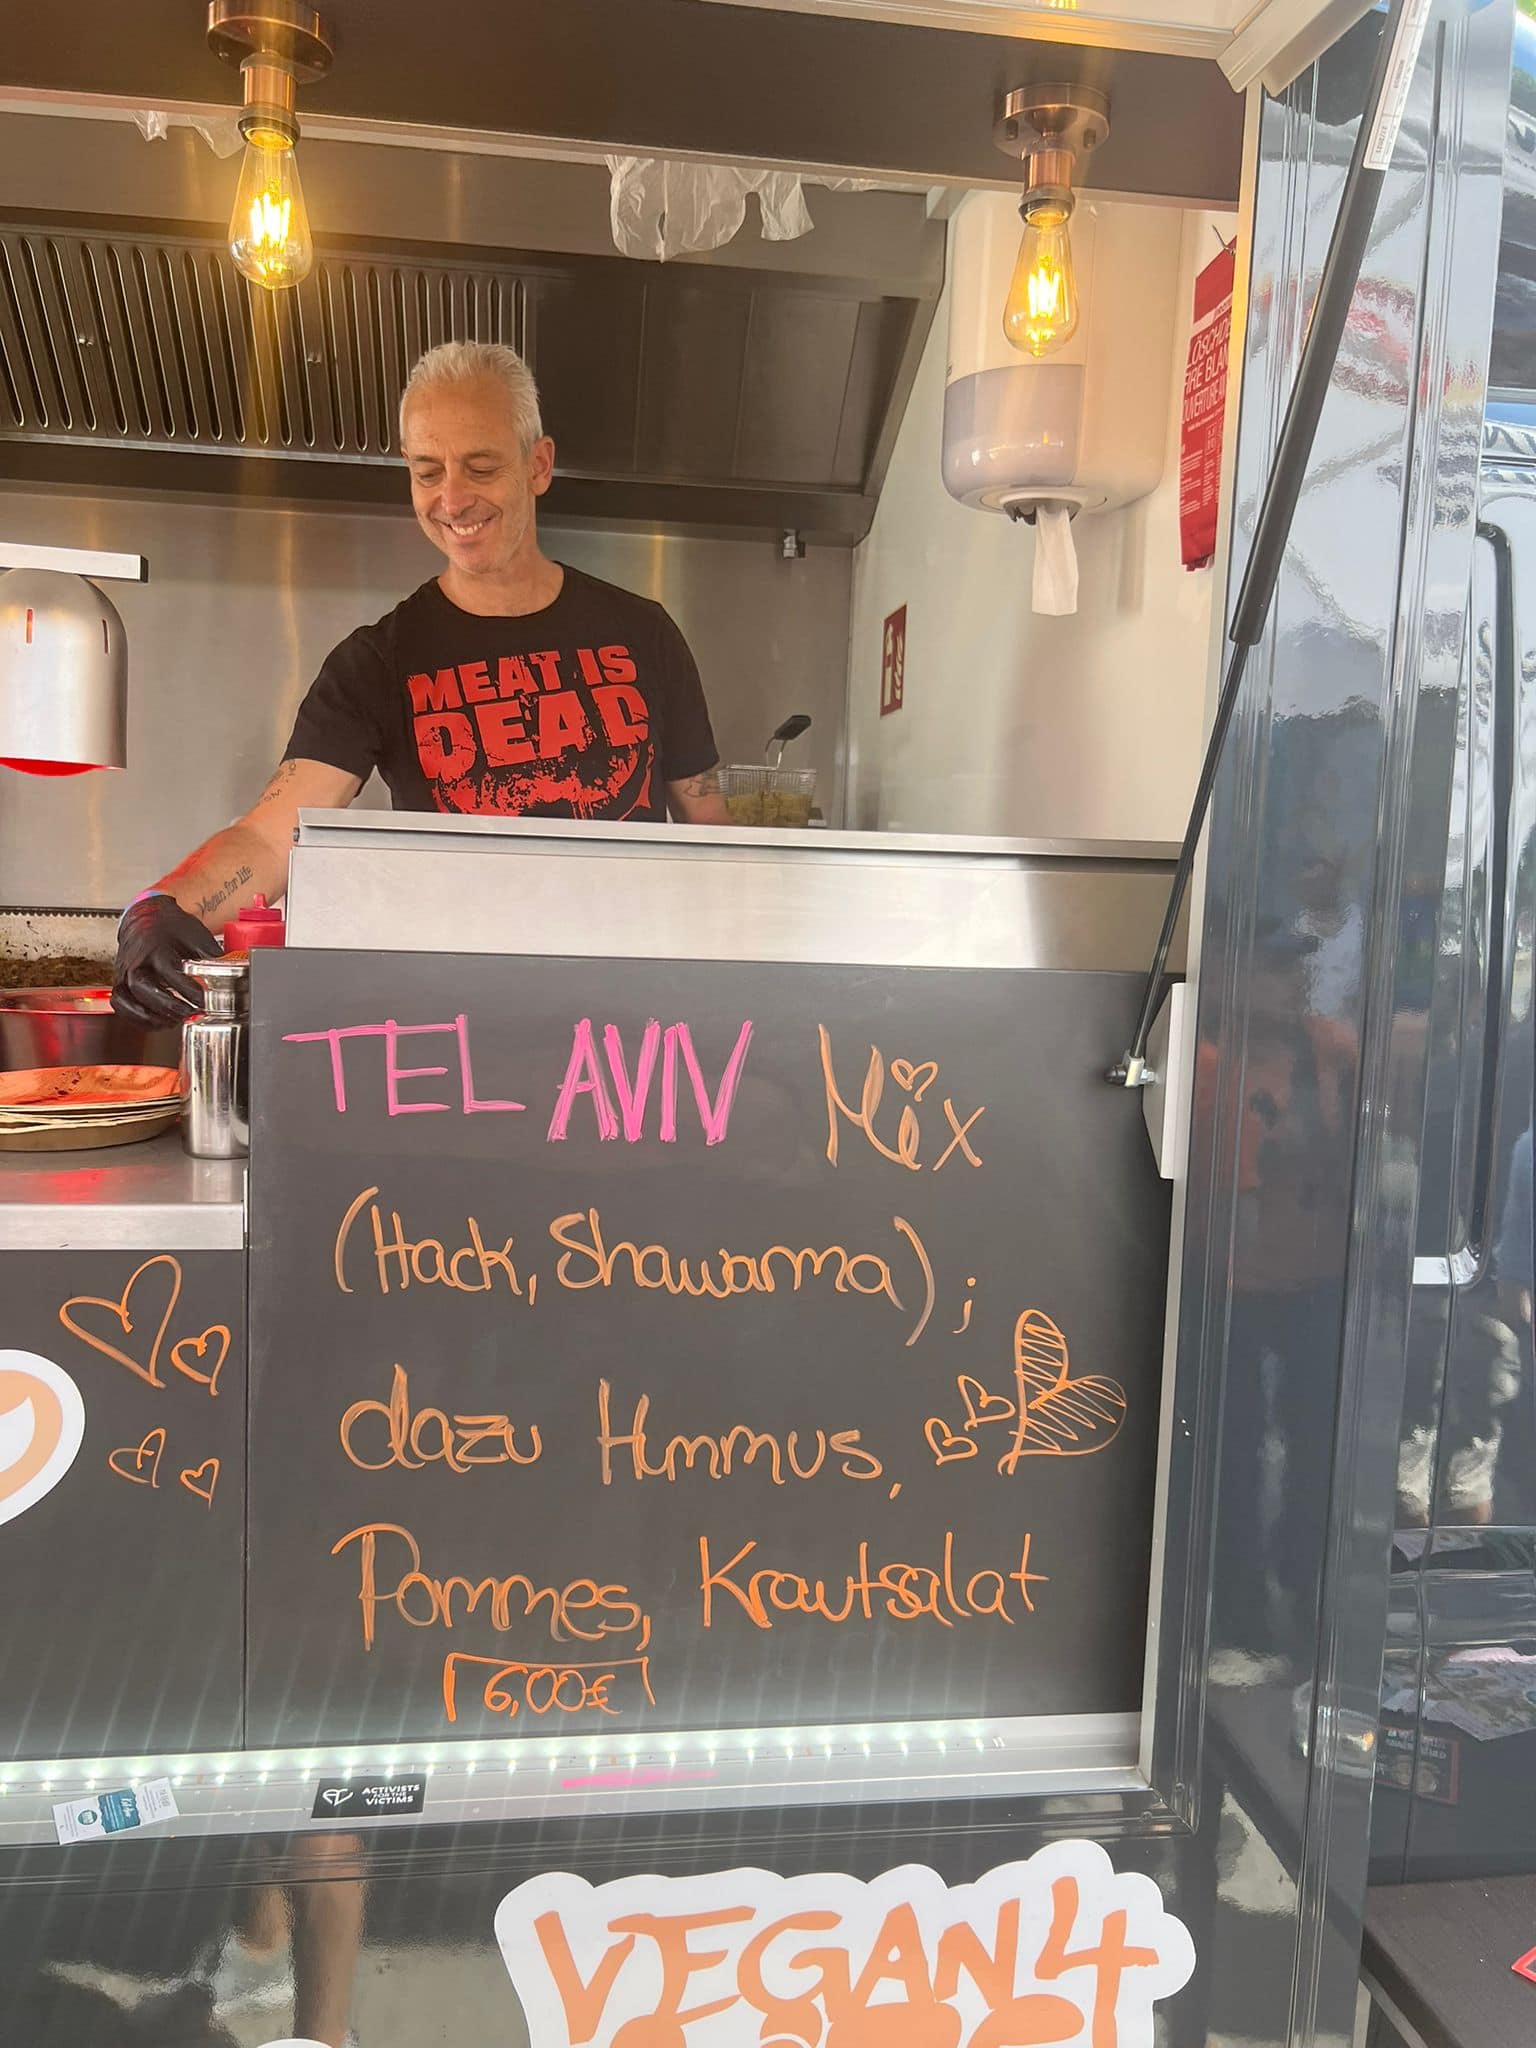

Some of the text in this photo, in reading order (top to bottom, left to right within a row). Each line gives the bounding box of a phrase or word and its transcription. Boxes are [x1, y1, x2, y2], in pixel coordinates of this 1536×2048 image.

[407, 645, 637, 713] MEAT IS
[413, 684, 648, 783] DEAD
[282, 1014, 985, 1171] TEL AVIV Mix
[339, 1363, 543, 1473] dazu
[332, 1522, 1050, 1651] Pommes, Krautsalat
[484, 1665, 623, 1718] 6,00€
[362, 1784, 420, 1795] ACTIVISTS
[366, 1796, 414, 1806] VICTIMS
